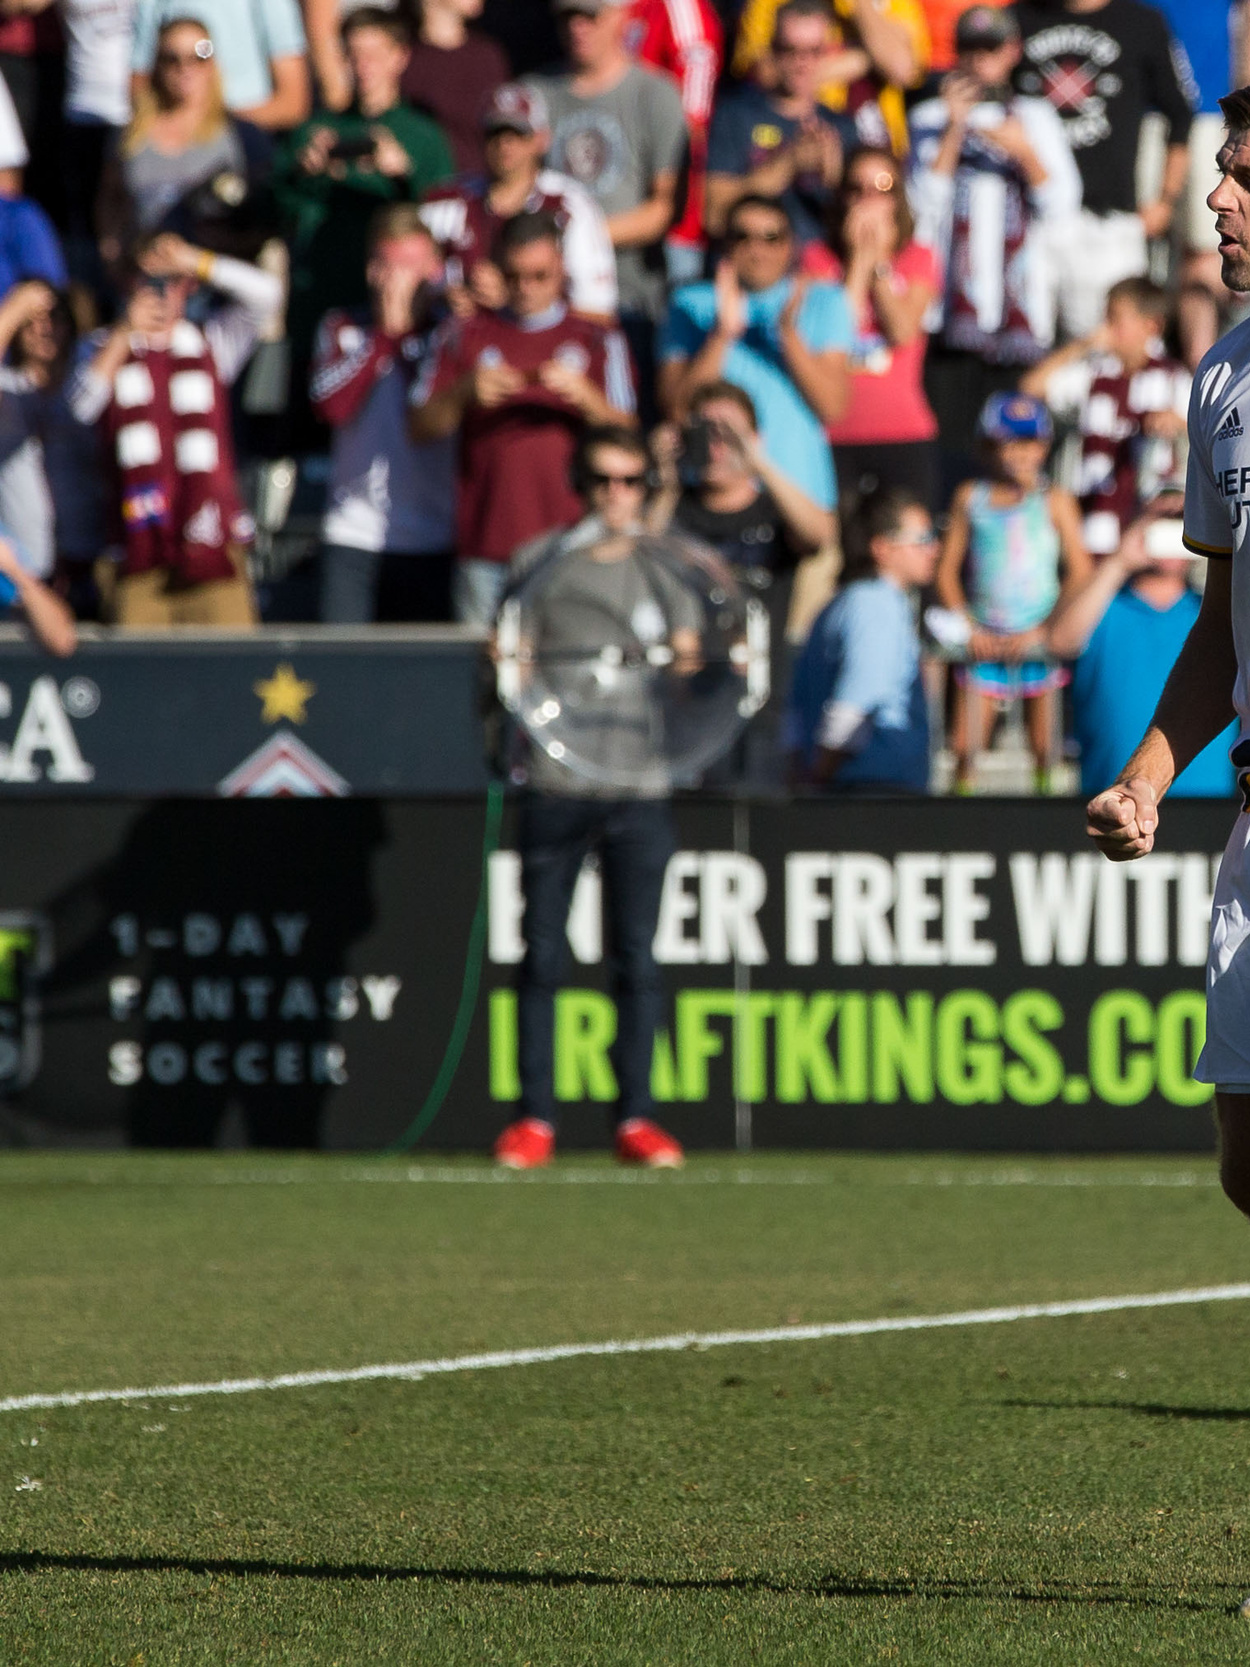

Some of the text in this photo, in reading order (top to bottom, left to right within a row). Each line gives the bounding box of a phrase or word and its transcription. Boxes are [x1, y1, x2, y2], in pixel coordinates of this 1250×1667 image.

[1218, 426, 1244, 441] adidas
[487, 850, 768, 966] EER
[785, 850, 998, 967] FREE
[110, 912, 309, 958] 1-DAY
[108, 974, 401, 1022] FANTASY
[108, 1040, 348, 1086] SOCCER
